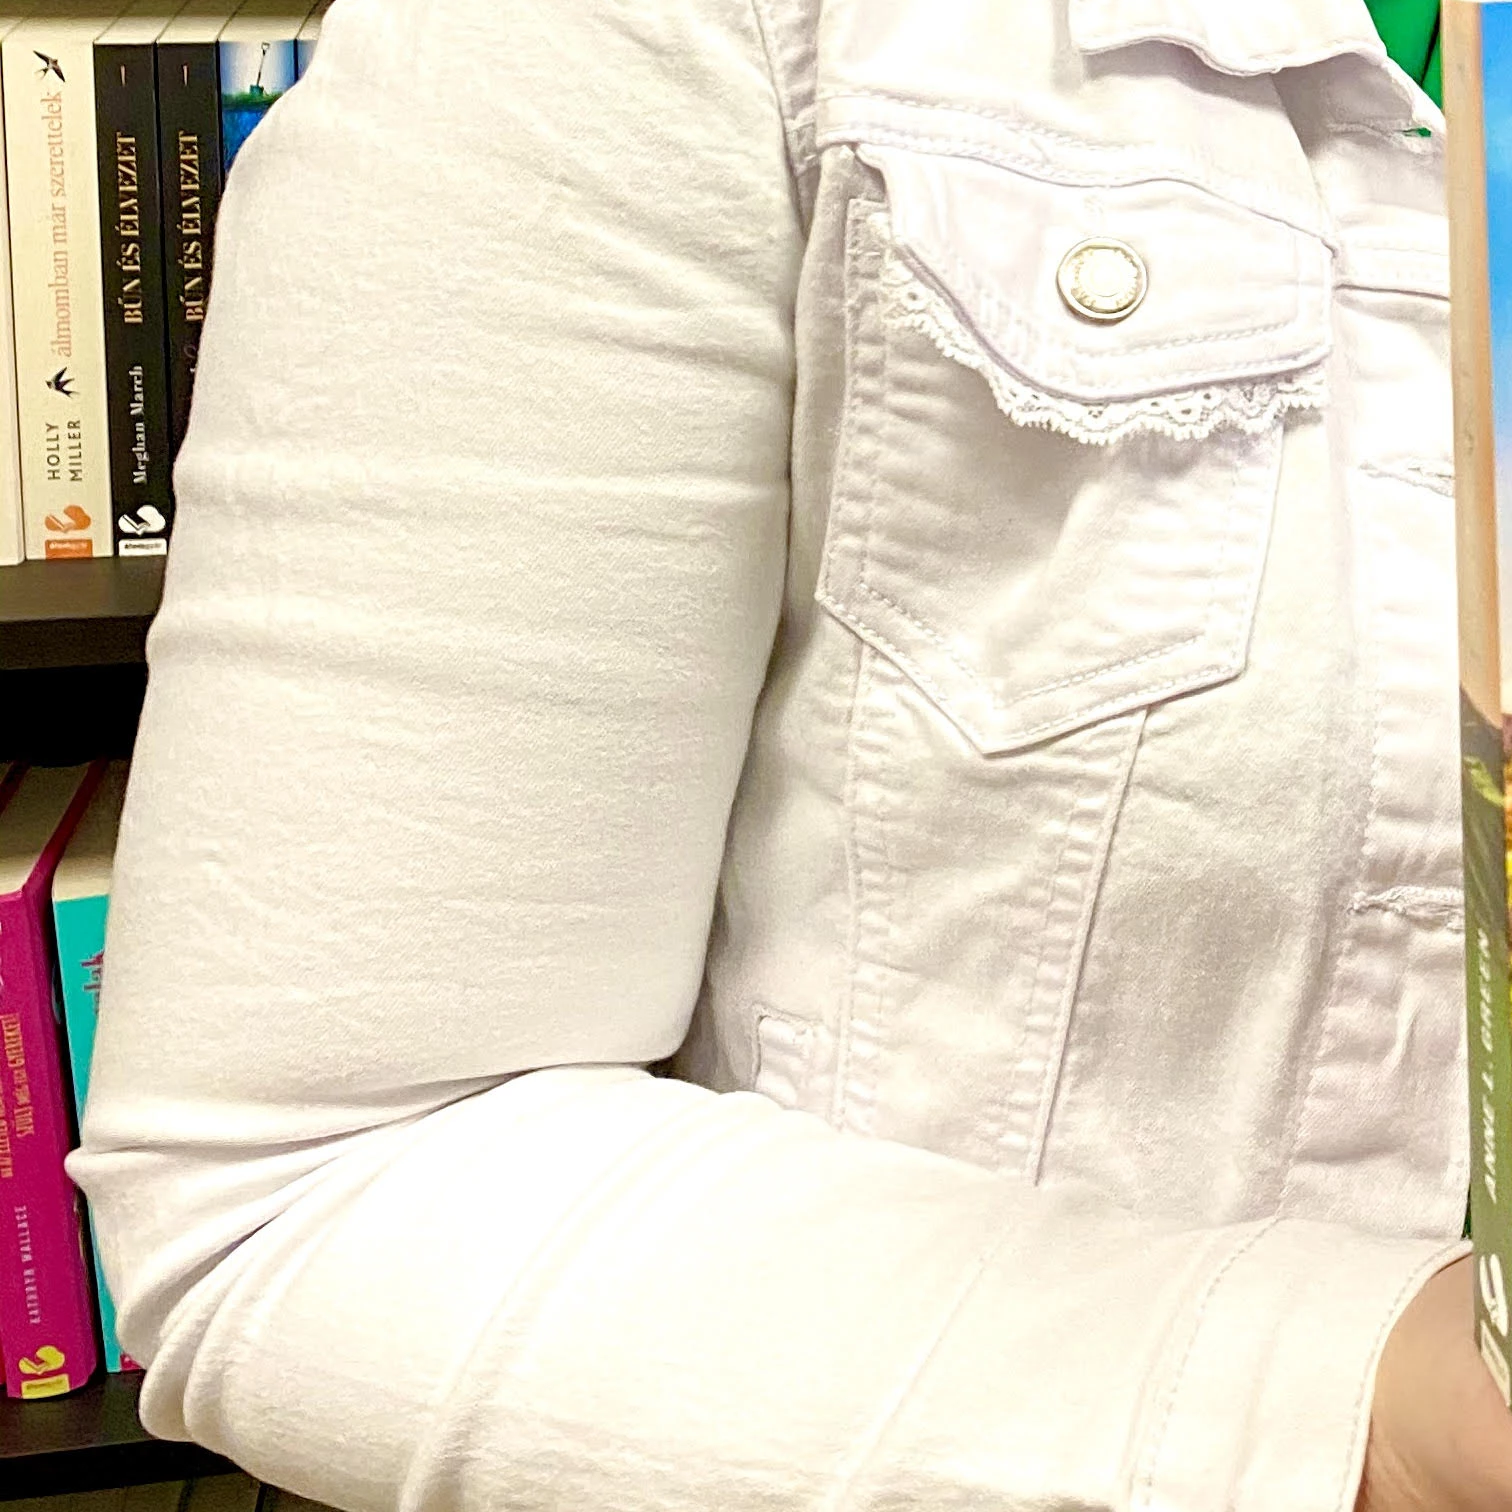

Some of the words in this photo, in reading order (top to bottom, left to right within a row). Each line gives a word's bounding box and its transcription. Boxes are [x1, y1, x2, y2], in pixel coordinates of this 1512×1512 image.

[46, 91, 69, 196] szerettelek
[46, 199, 68, 243] már
[44, 246, 73, 358] álmomban
[131, 365, 144, 413] March
[47, 421, 60, 481] HOLLY
[70, 419, 82, 482] MILLER
[133, 415, 147, 485] Meghan
